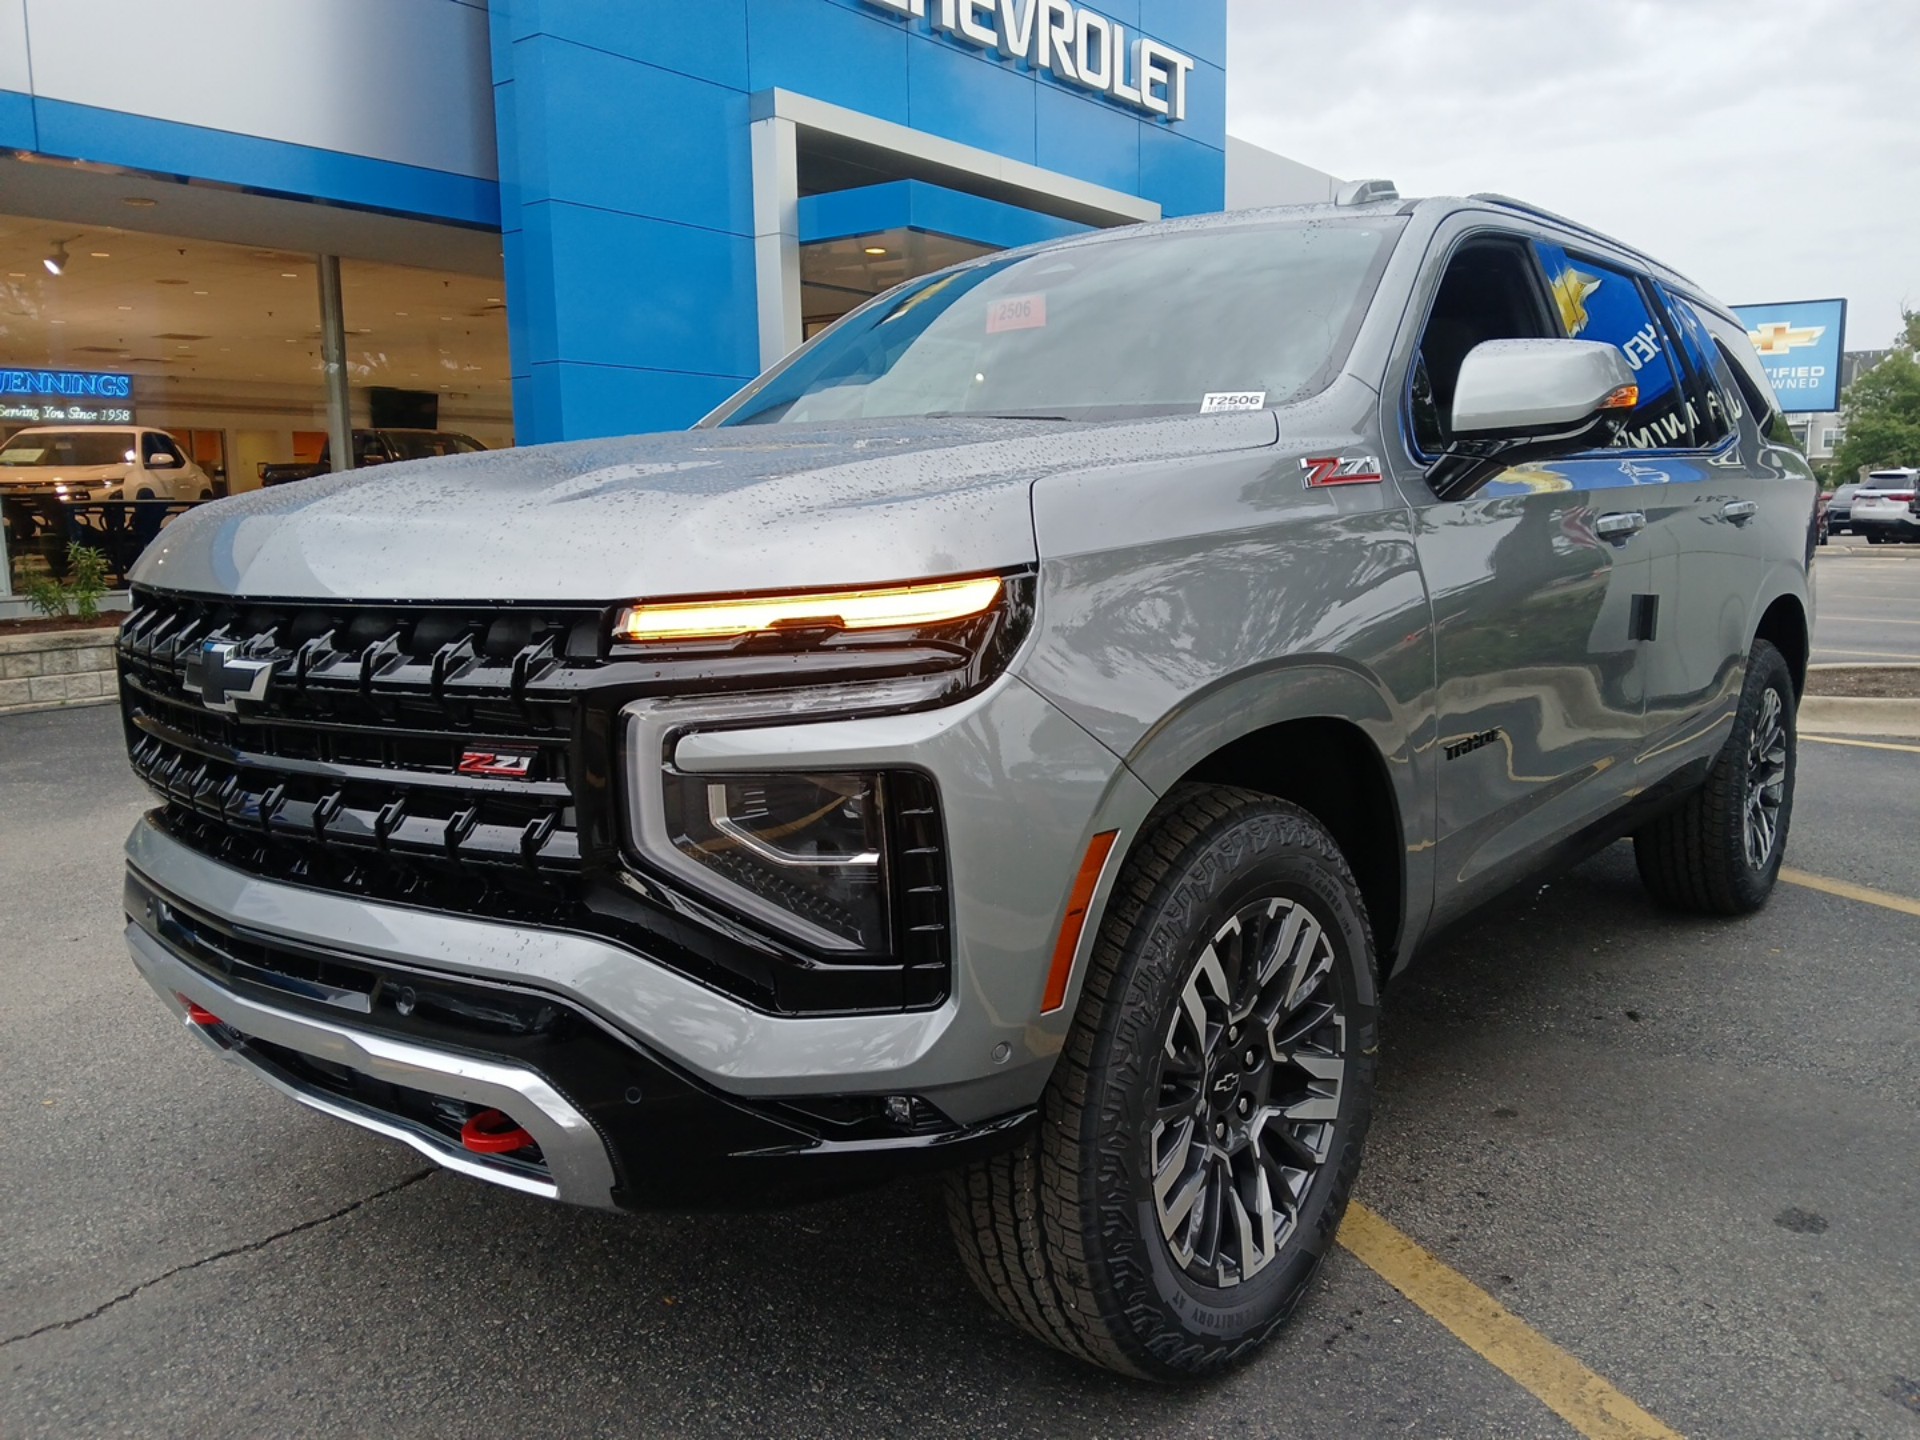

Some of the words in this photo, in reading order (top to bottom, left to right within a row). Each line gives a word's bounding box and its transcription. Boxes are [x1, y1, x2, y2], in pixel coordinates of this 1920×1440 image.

[866, 0, 1194, 122] EVROLET
[0, 371, 129, 396] JENNINGS
[1207, 395, 1260, 406] T2506
[0, 404, 39, 421] Serving
[43, 406, 65, 419] You
[68, 406, 98, 420] Since
[101, 409, 131, 421] 1958
